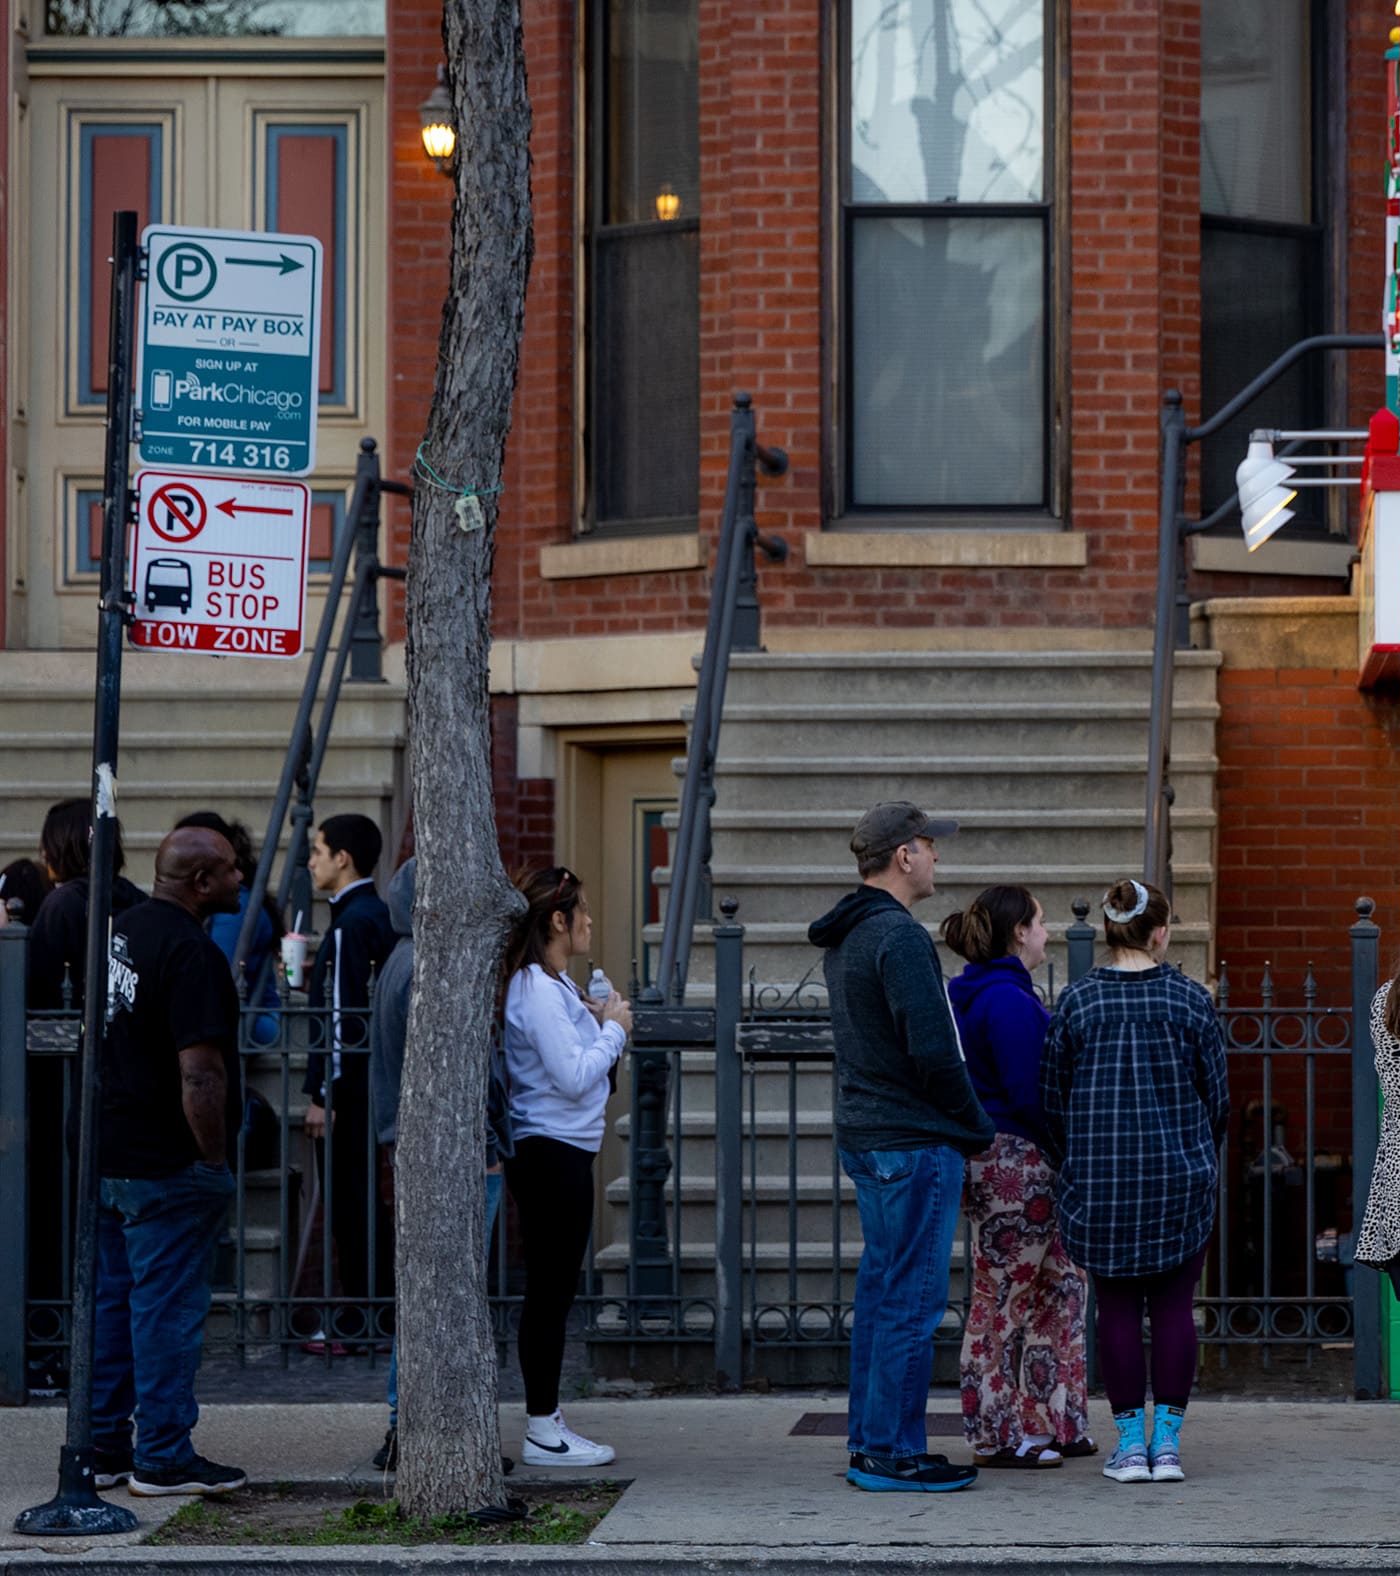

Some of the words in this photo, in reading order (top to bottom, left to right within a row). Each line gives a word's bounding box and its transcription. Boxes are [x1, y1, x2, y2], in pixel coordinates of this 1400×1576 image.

[175, 254, 203, 289] P
[153, 311, 189, 328] PAY
[192, 314, 216, 329] AT
[222, 316, 257, 332] PAY
[263, 320, 304, 336] BOX
[219, 337, 236, 347] OR
[195, 358, 223, 371] SIGN
[226, 360, 242, 371] UP
[244, 362, 259, 372] AT
[175, 380, 302, 411] ParkChicago
[177, 415, 201, 427] FOR
[204, 417, 247, 430] MOBILE
[250, 421, 272, 431] PAY
[274, 410, 302, 420] .com
[148, 444, 175, 456] ZONE
[189, 440, 235, 464] 714
[243, 444, 290, 468] 316
[208, 560, 265, 590] BUS
[206, 592, 279, 621] STOP
[142, 622, 198, 647] TOW
[213, 627, 286, 653] ZONE
